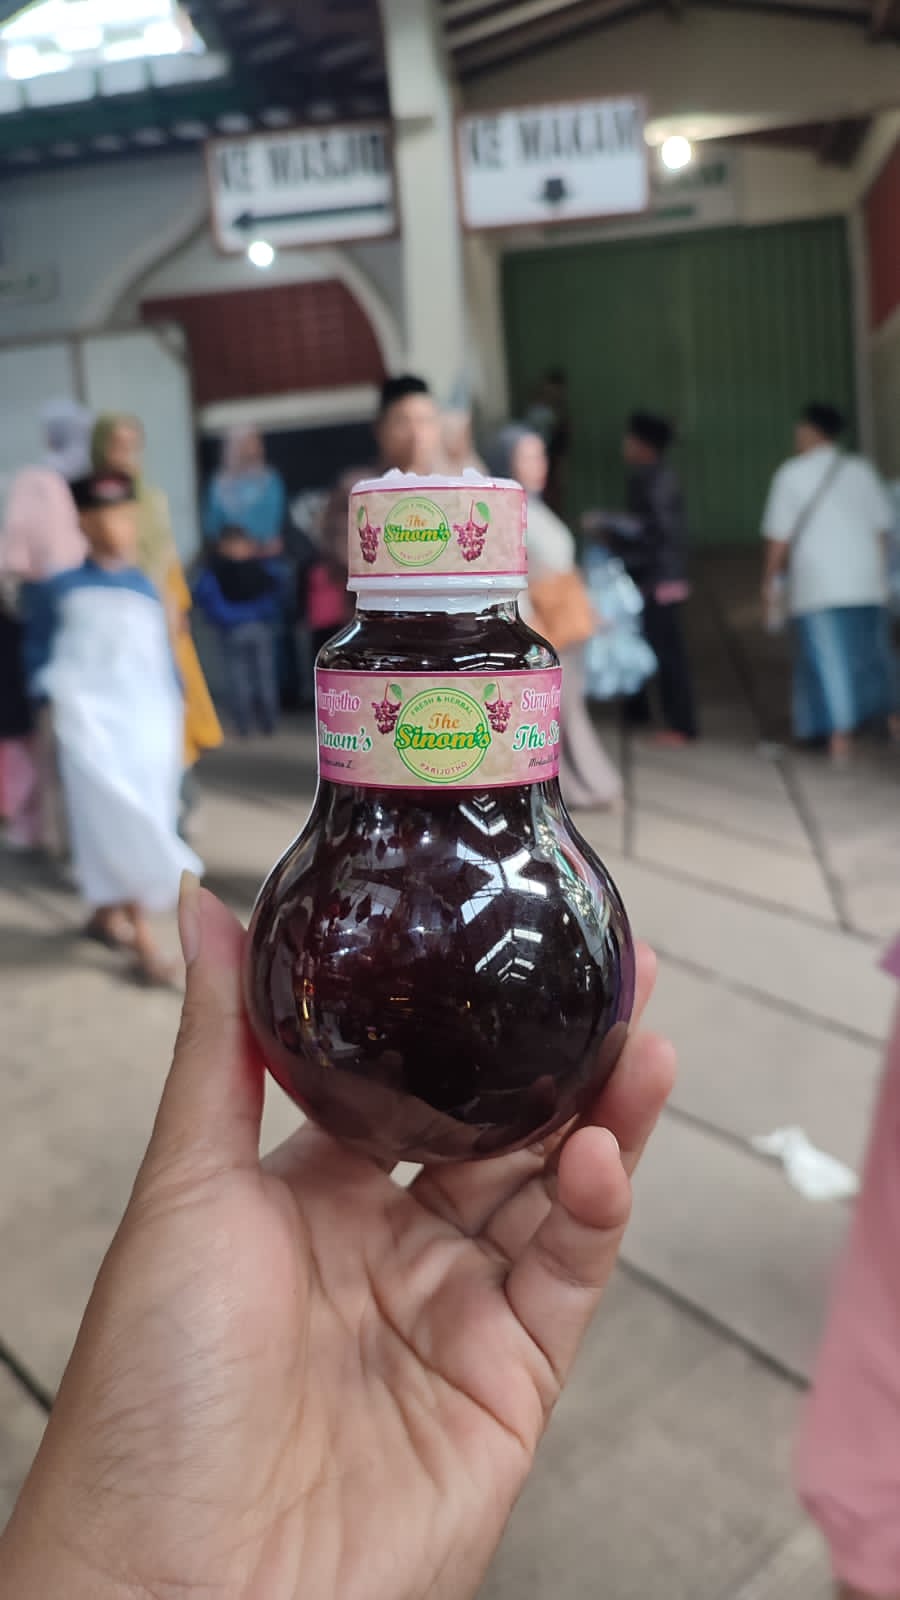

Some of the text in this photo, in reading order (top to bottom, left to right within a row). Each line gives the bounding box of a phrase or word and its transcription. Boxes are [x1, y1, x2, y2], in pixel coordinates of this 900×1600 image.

[428, 712, 461, 730] The
[394, 723, 492, 750] Sinom's
[511, 722, 547, 751] The
